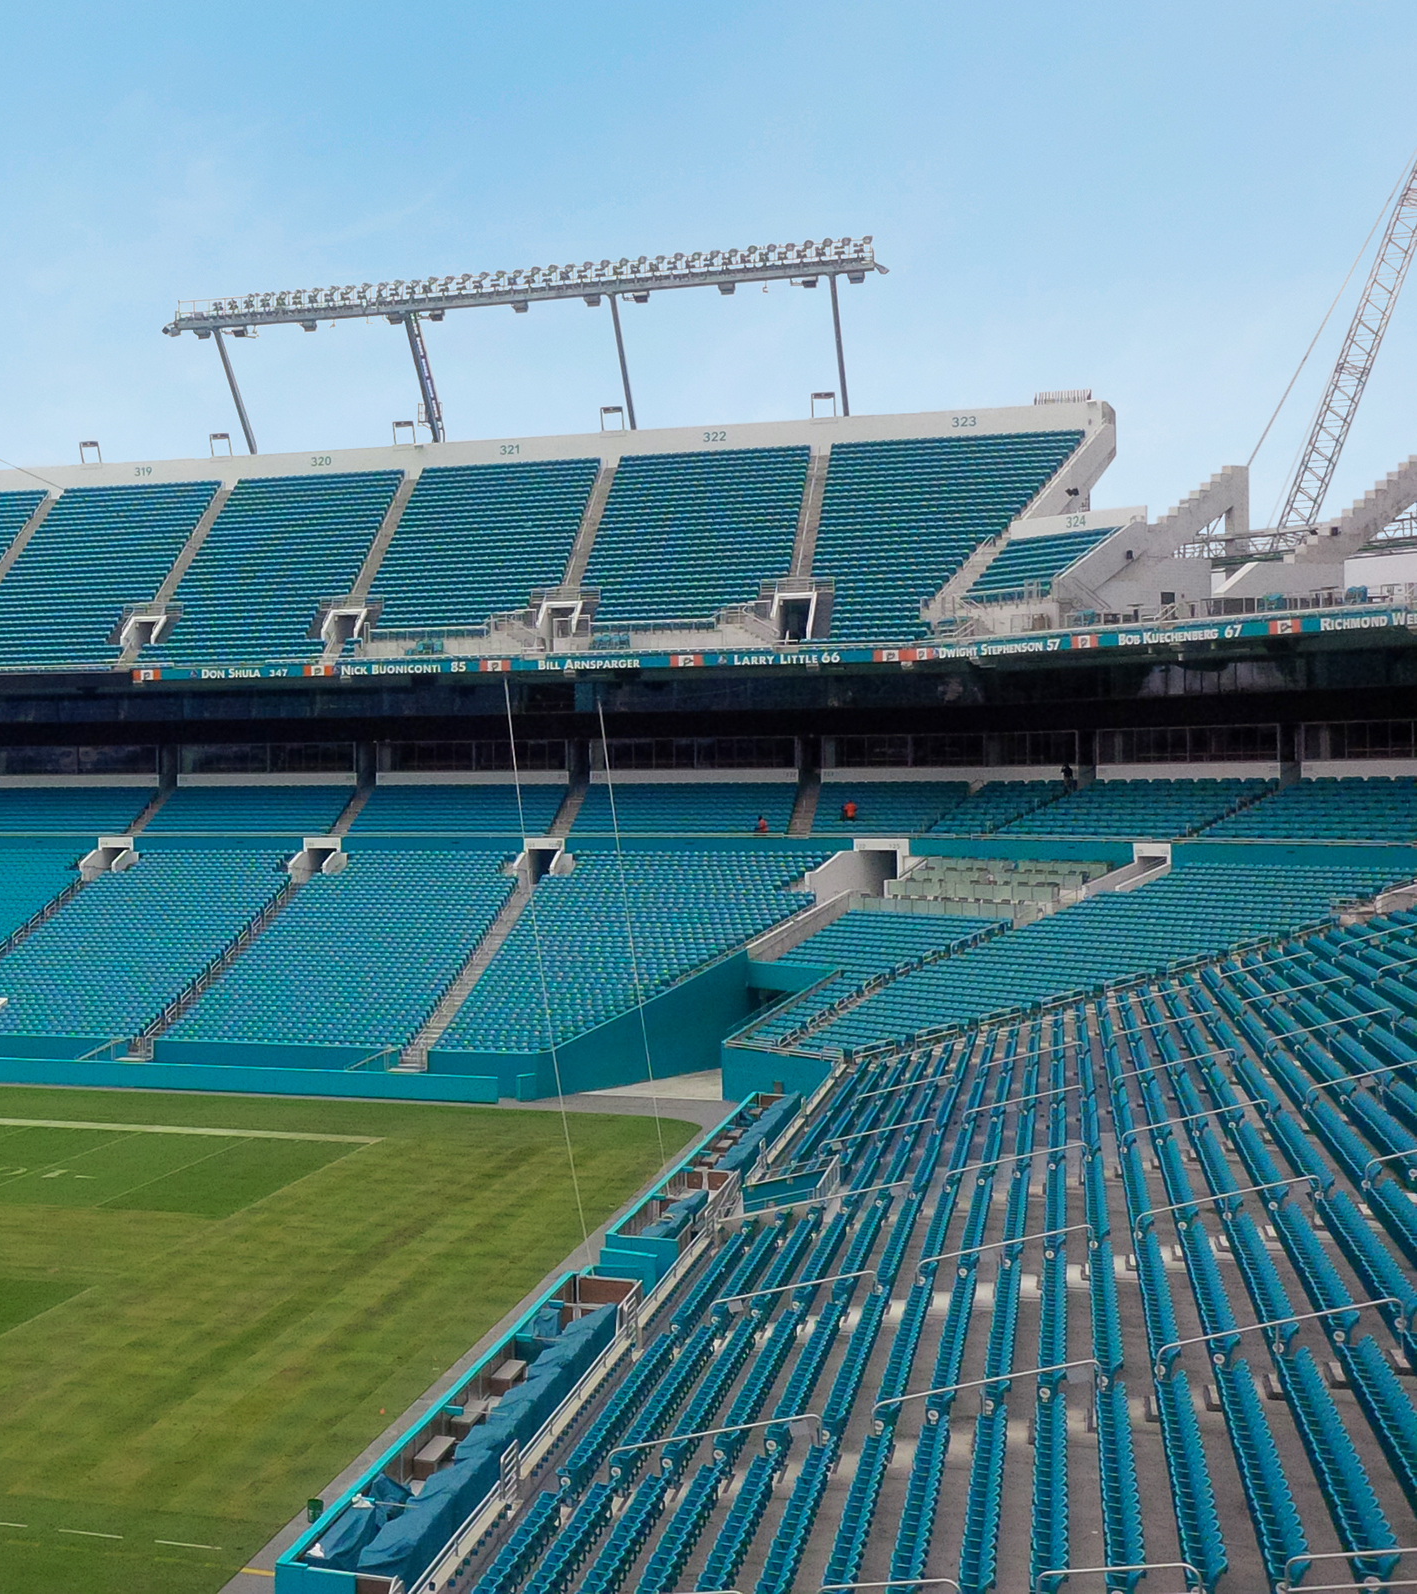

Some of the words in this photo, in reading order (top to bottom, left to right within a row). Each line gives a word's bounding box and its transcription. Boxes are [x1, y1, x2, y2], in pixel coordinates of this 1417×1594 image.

[952, 416, 977, 428] 323
[703, 431, 727, 442] 322
[500, 444, 520, 455] 321
[311, 456, 332, 467] 320
[134, 467, 152, 477] 319
[1066, 515, 1086, 528] 324
[1320, 615, 1388, 631] RICHMOND
[1118, 633, 1141, 646] BOB
[1143, 628, 1219, 644] KUECHENBERG
[1224, 624, 1243, 638] 67
[938, 647, 977, 659] DWIGHT
[981, 642, 1043, 656] STEPHENSON
[1046, 638, 1061, 651] 57
[538, 659, 561, 670] BILL
[563, 659, 640, 670] ARNSPARGER
[733, 654, 775, 666] LARRY
[780, 654, 818, 664] LITTLE
[821, 652, 840, 663] 66
[201, 669, 225, 679] DON
[228, 668, 261, 678] SHULA
[269, 668, 288, 677] 347
[341, 665, 368, 676] NICK
[371, 664, 441, 675] BUONICONTI
[450, 661, 466, 672] 85
